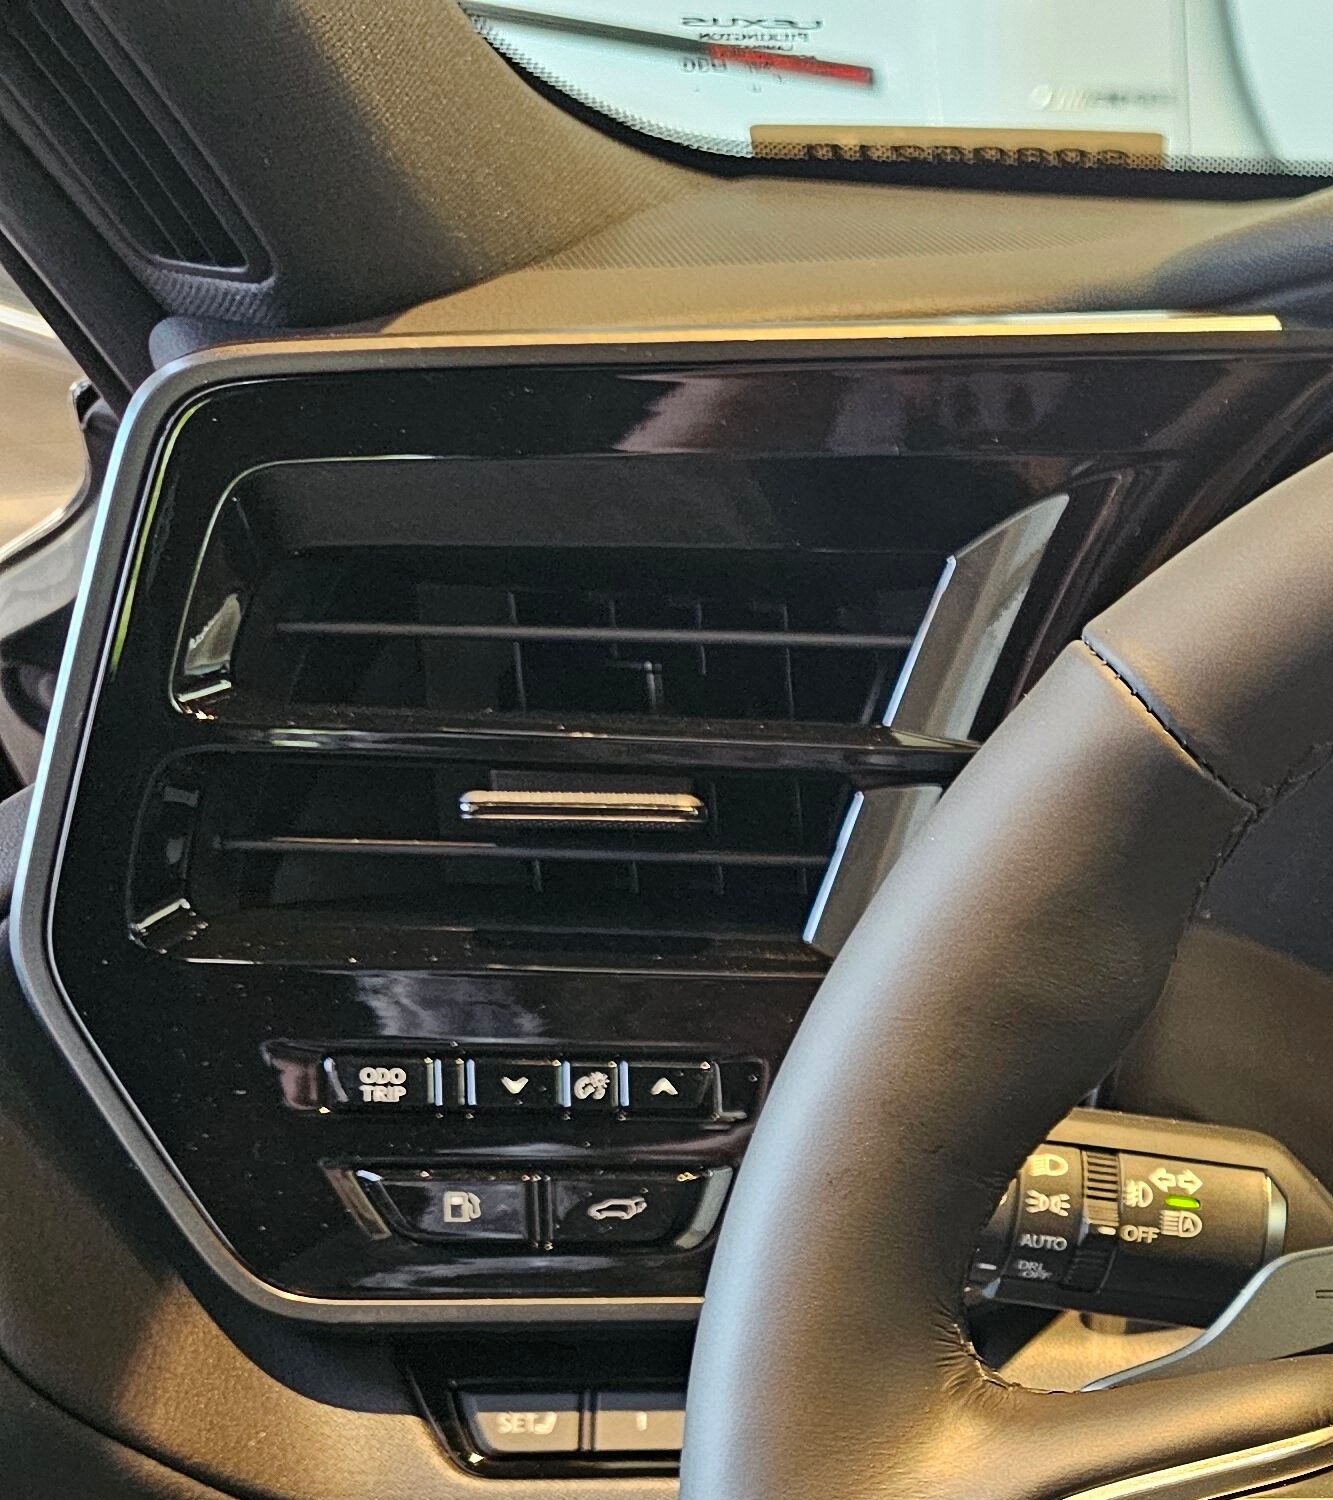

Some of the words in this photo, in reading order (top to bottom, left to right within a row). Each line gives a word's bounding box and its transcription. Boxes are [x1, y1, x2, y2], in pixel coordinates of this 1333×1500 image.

[358, 1066, 407, 1086] ODO
[358, 1085, 407, 1103] TRIP
[1019, 1232, 1068, 1252] AUTO
[1120, 1225, 1160, 1244] OFF
[1017, 1258, 1046, 1273] DRL
[498, 1415, 538, 1434] SET
